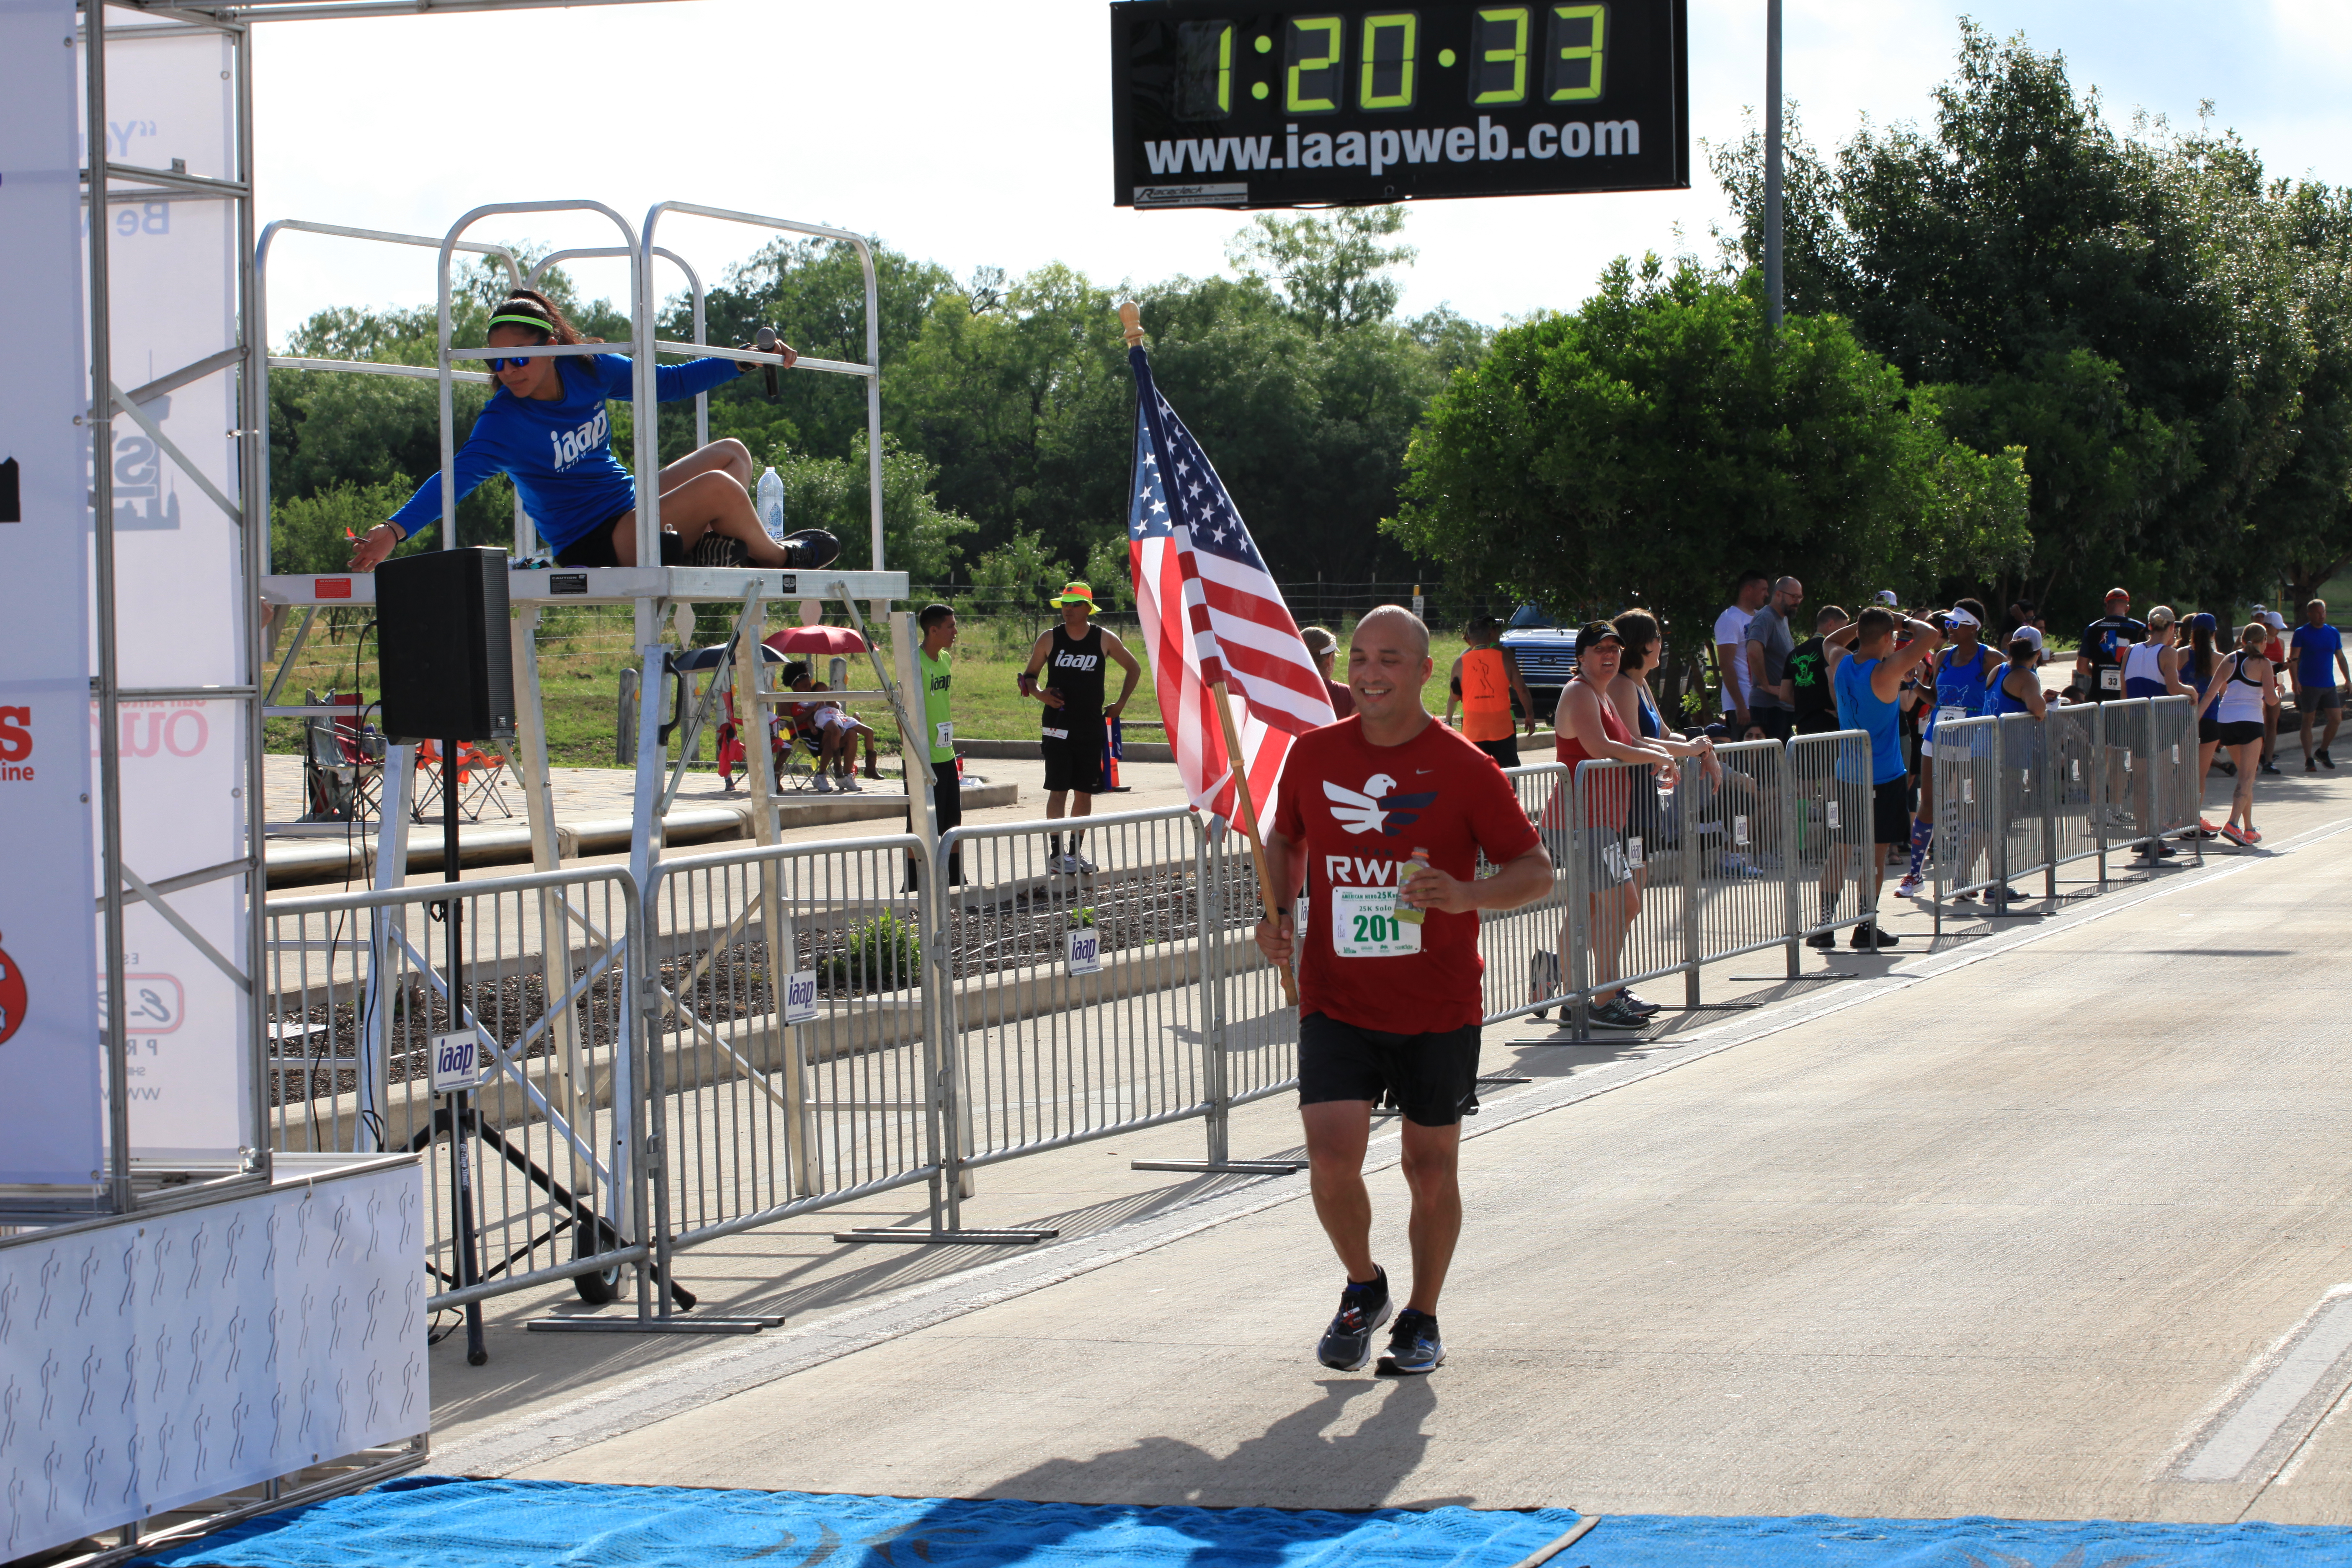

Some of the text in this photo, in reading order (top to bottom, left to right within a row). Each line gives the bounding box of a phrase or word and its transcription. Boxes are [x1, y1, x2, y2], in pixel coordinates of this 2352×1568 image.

[1144, 115, 1640, 176] www.iaapweb.com
[551, 409, 607, 469] iaap
[1055, 650, 1097, 671] iaap
[930, 674, 951, 691] iaap
[944, 732, 949, 742] 11
[1354, 846, 1393, 856] TEAM
[1353, 915, 1399, 942] 201
[1071, 934, 1096, 963] iaap
[788, 975, 814, 1009] iaap
[438, 1038, 474, 1076] iaap
